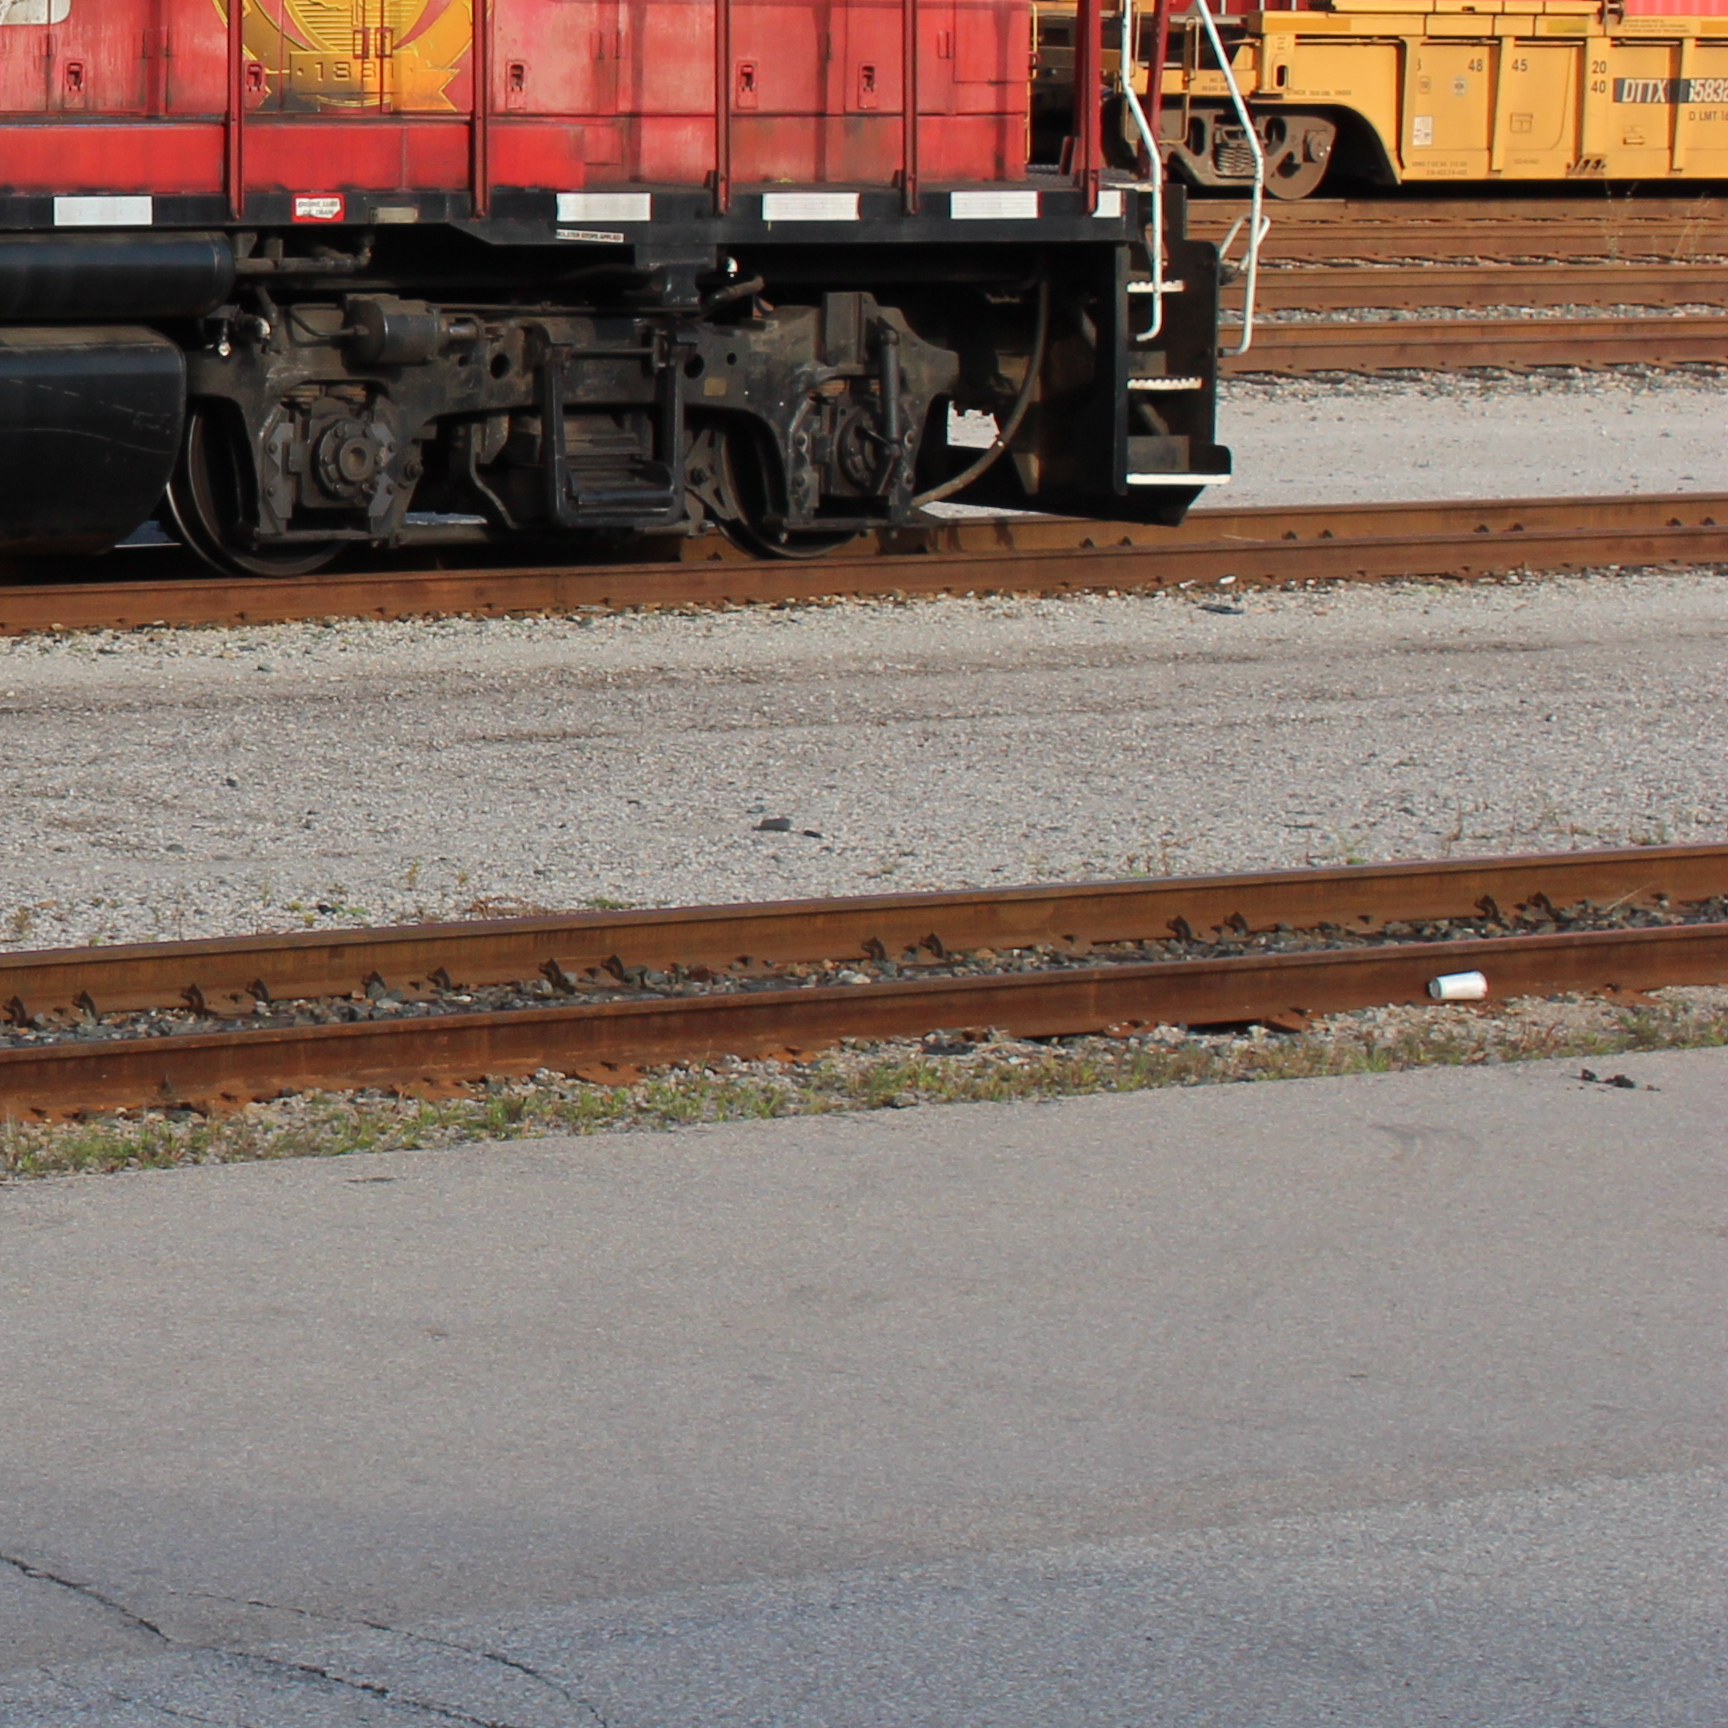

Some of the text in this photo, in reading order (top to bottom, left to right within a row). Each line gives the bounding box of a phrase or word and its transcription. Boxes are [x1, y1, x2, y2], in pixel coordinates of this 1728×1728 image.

[1468, 58, 1483, 72] 48
[1512, 58, 1528, 72] 45
[1592, 60, 1606, 74] 20
[1591, 80, 1606, 93] 40
[1622, 78, 1668, 103] DTTX
[1699, 111, 1717, 121] LMT
